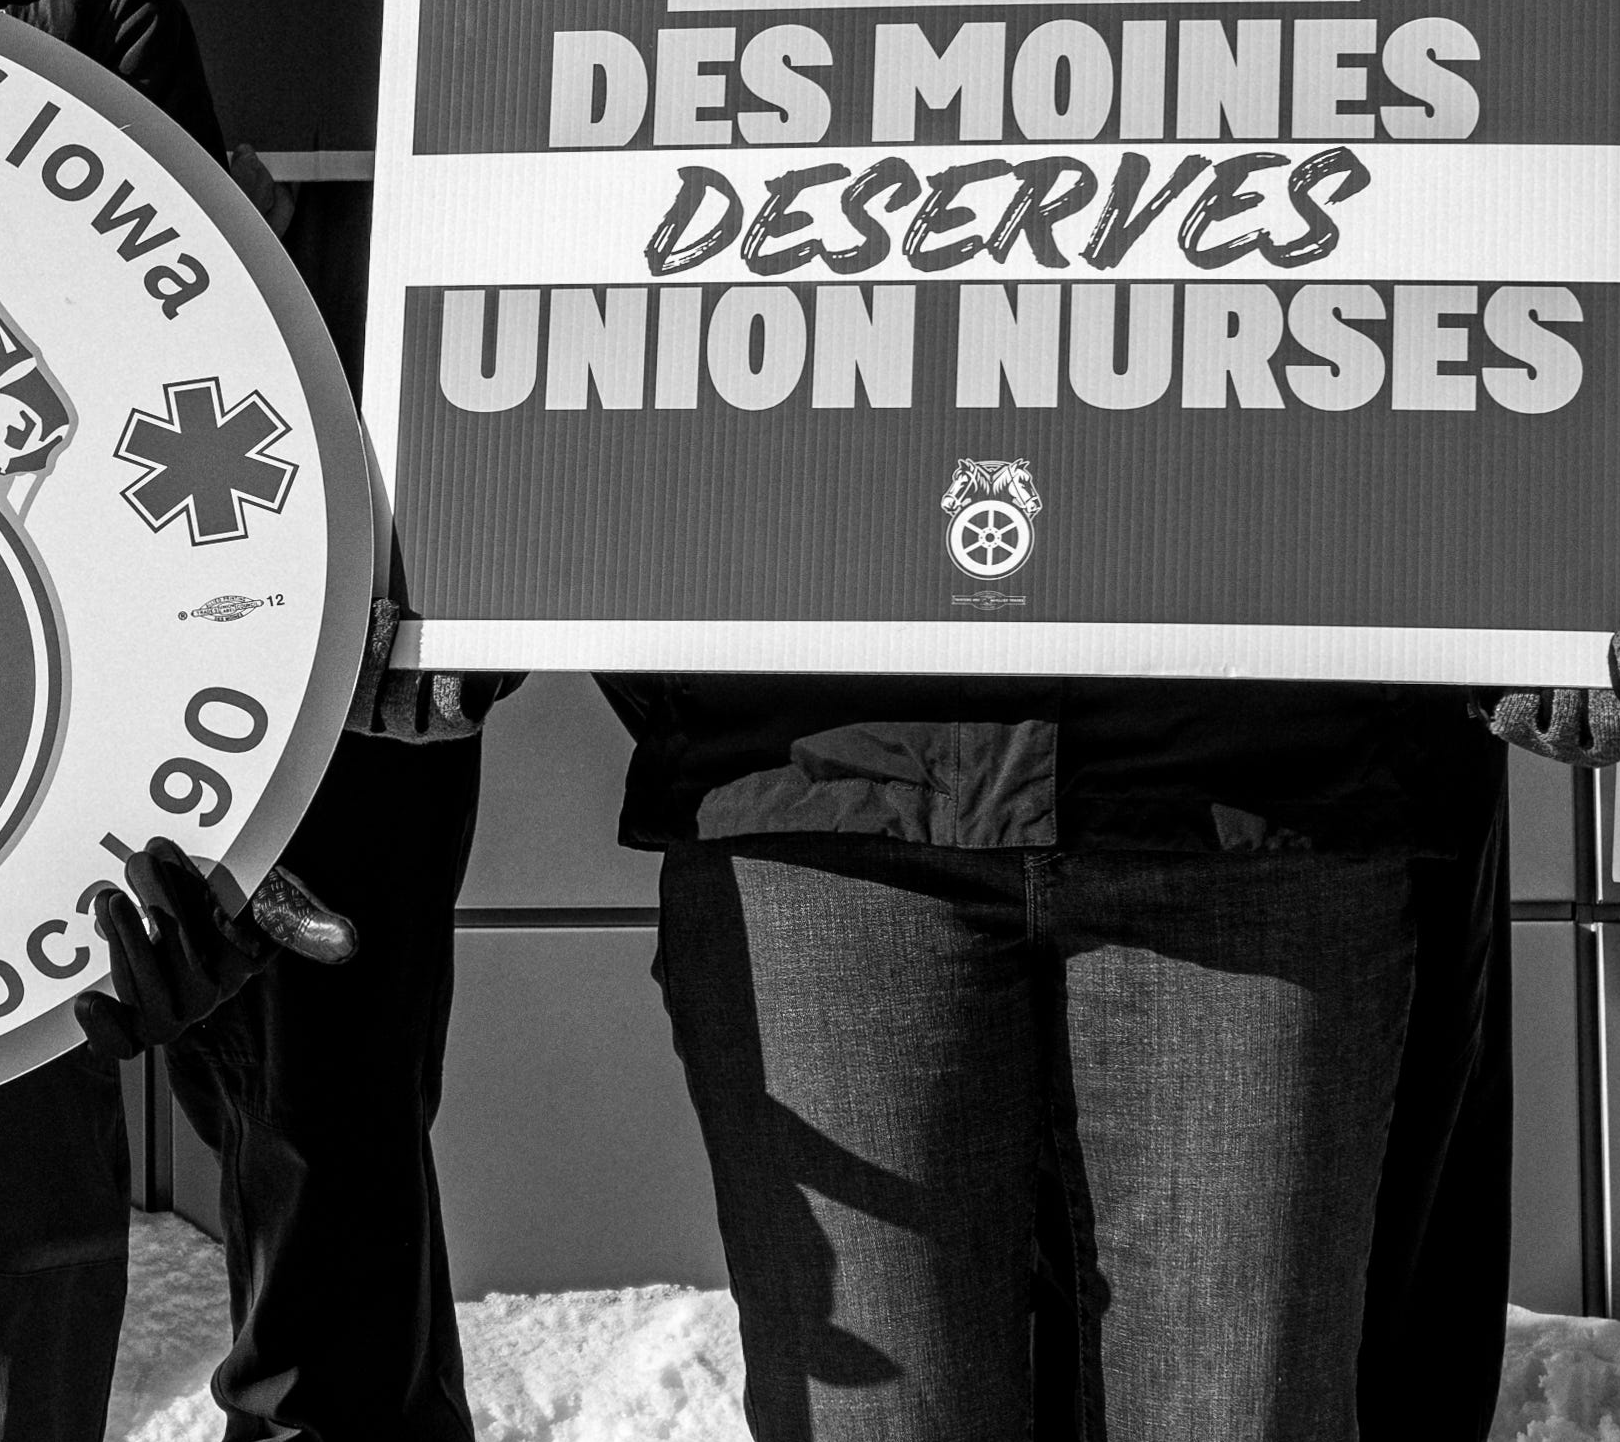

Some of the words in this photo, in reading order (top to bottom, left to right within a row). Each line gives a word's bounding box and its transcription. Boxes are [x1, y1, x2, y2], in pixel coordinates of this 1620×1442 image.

[548, 19, 834, 148] DES
[871, 15, 1483, 144] MOINES
[4, 99, 217, 320] Iowa
[644, 144, 1373, 277] DESERVES
[438, 286, 925, 415] UNION
[954, 282, 1586, 416] NURSES
[266, 594, 286, 607] 12
[147, 685, 272, 829] 90
